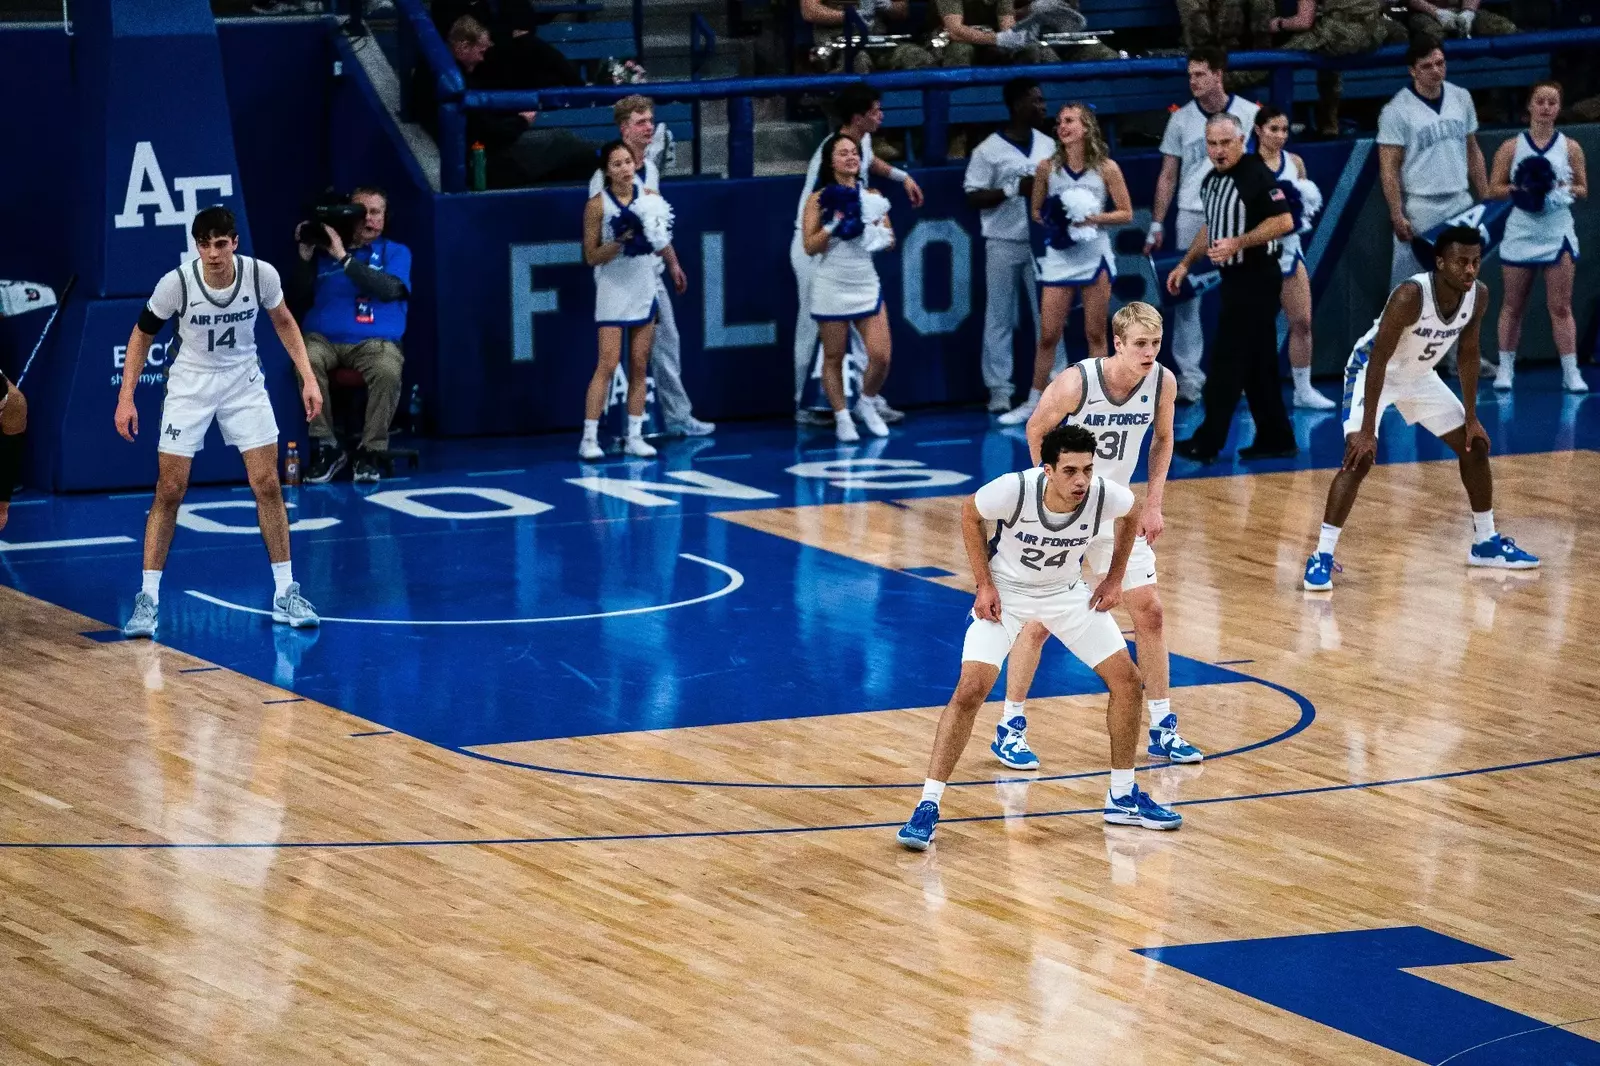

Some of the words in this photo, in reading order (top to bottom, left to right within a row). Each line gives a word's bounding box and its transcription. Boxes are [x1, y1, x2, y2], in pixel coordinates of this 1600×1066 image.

[190, 314, 211, 326] AIR
[214, 308, 255, 324] FORCE
[207, 326, 236, 352] 14
[1418, 341, 1444, 361] 5
[1083, 413, 1105, 426] AIR
[1108, 413, 1150, 425] FORCE
[1096, 430, 1128, 460] 31
[1014, 531, 1038, 545] AIR
[1041, 535, 1089, 547] FORCE
[1020, 548, 1070, 571] 24
